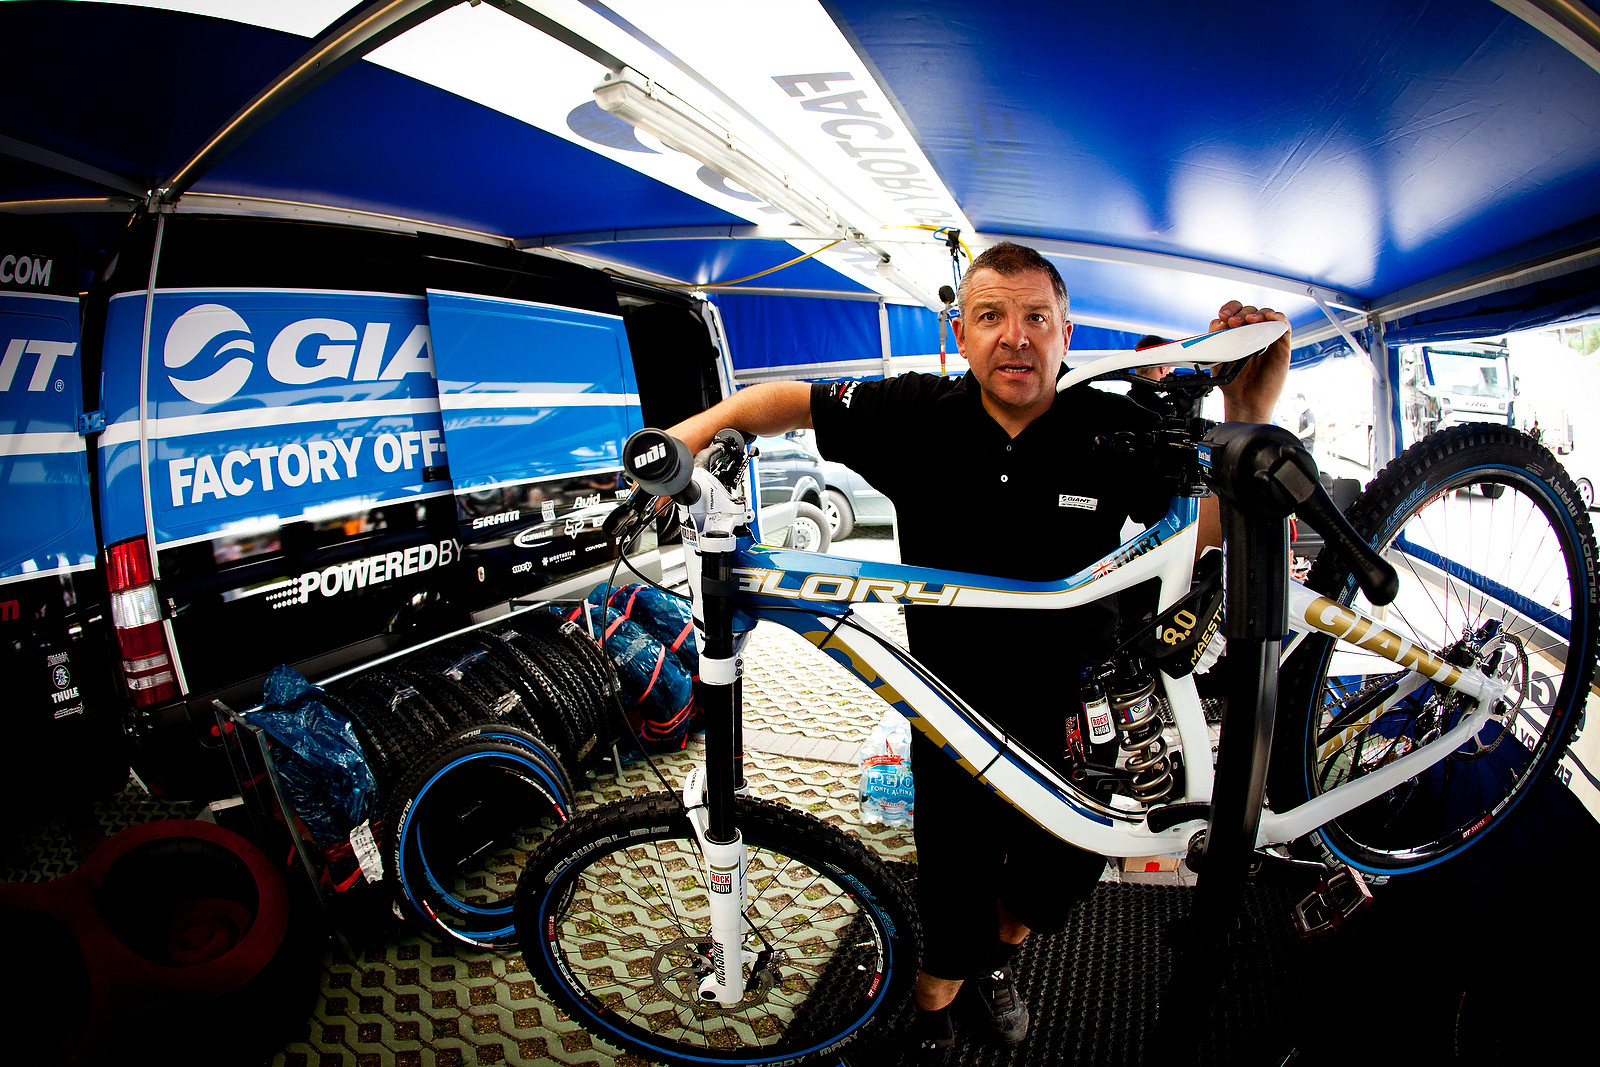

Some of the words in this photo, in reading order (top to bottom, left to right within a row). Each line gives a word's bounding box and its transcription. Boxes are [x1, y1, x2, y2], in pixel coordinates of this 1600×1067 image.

[168, 436, 364, 507] FACTORY
[572, 493, 601, 509] Avid
[472, 510, 520, 530] SRAM
[1113, 530, 1163, 569] HART
[1163, 609, 1197, 646] 8.0
[1304, 596, 1462, 687] GIANT
[51, 687, 79, 703] THULE
[1092, 715, 1108, 726] ROCK
[871, 786, 890, 795] FONTE
[711, 873, 730, 884] ROCK
